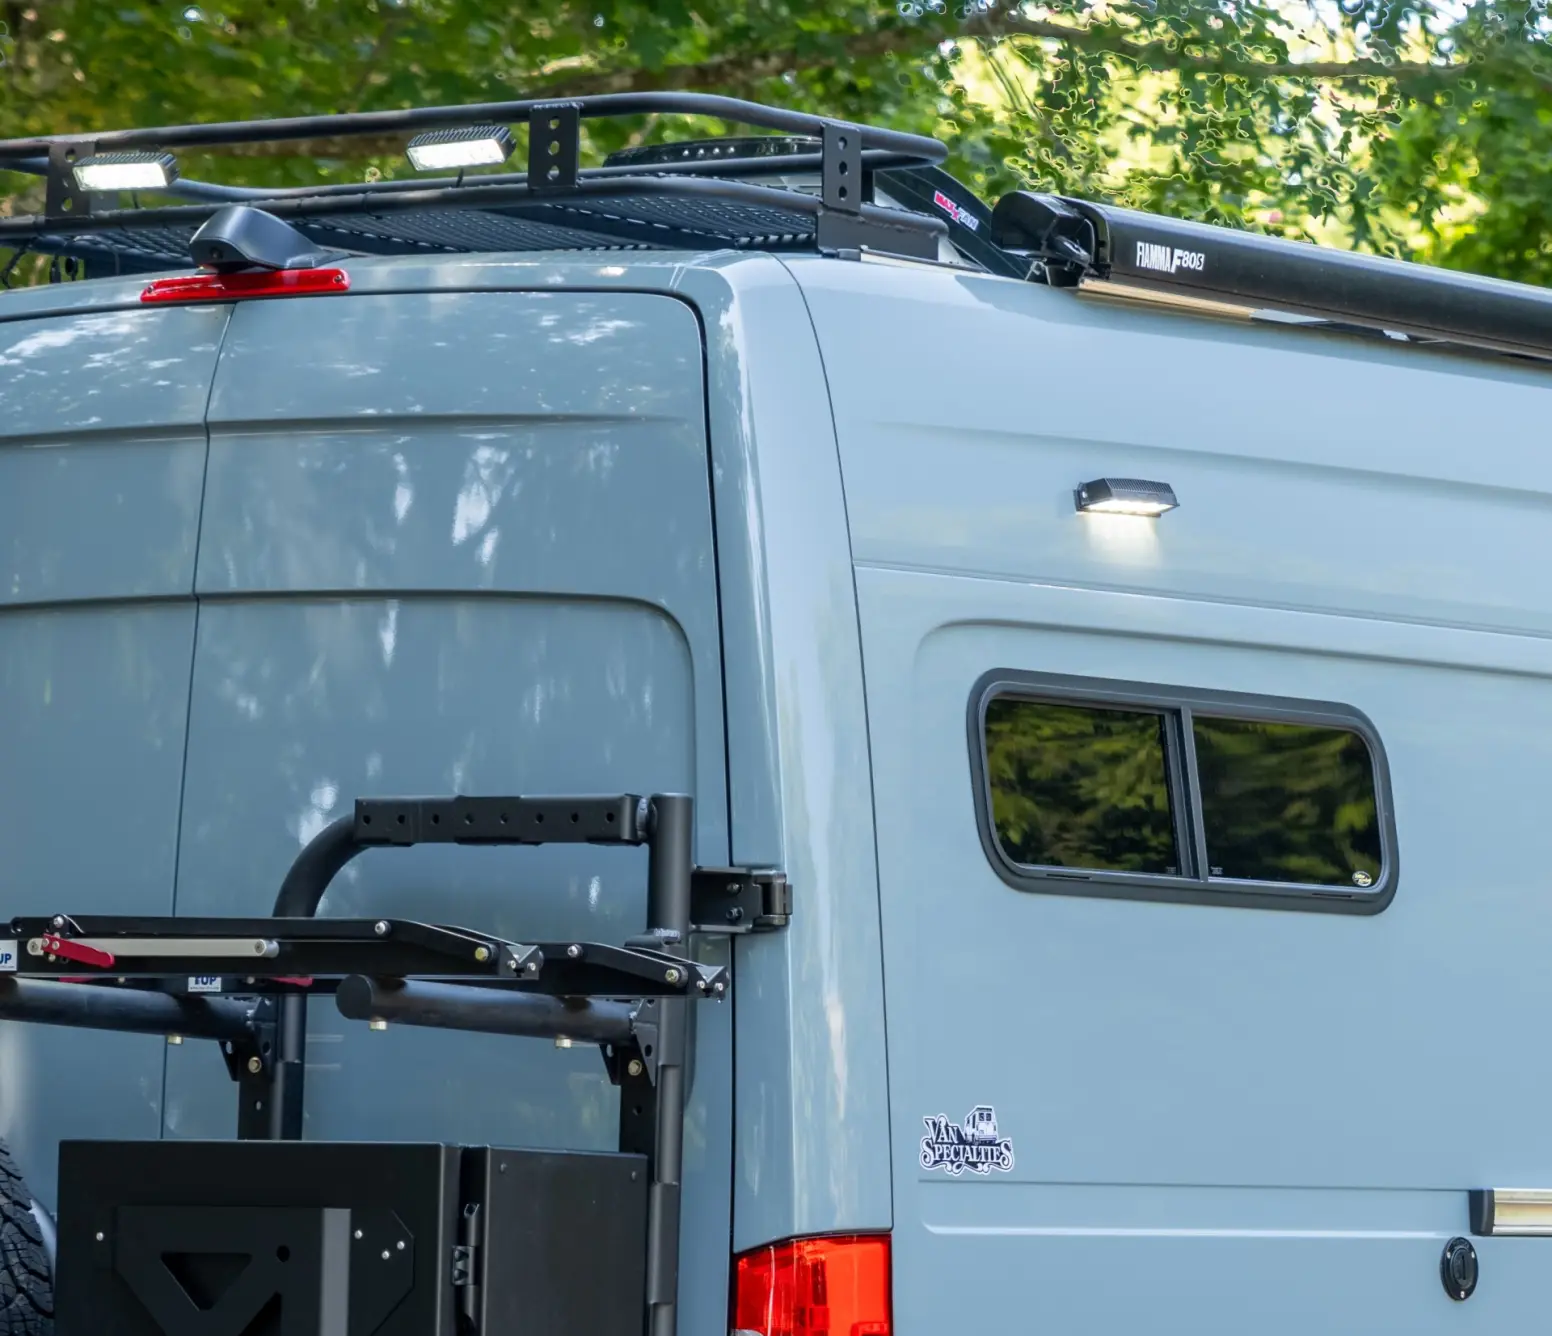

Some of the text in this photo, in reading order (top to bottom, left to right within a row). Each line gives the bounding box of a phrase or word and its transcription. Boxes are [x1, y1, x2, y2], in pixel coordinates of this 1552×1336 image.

[1136, 241, 1172, 272] FIAMMA
[923, 1115, 959, 1144] VAN
[920, 1137, 1014, 1172] SPECIALTIES
